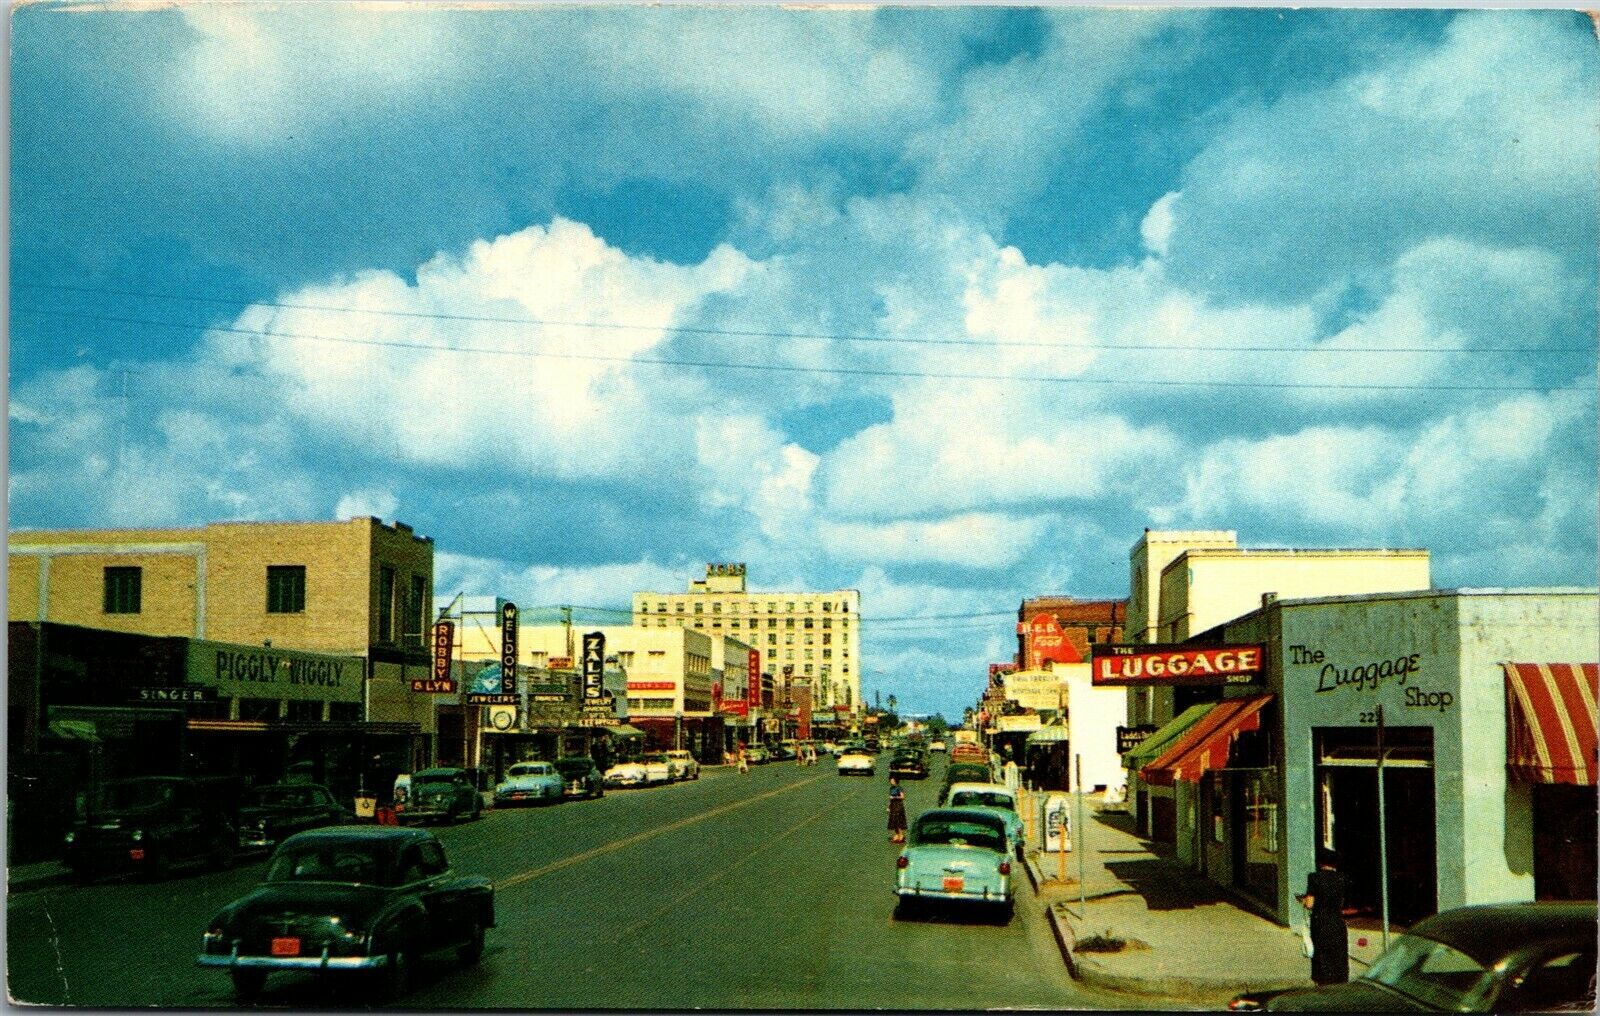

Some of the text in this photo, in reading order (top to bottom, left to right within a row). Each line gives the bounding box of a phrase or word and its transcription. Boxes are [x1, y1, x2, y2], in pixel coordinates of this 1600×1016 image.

[437, 625, 449, 678] ROBBY
[504, 608, 515, 689] WELDONS
[1113, 647, 1134, 655] THE
[1289, 644, 1325, 665] The
[215, 651, 344, 687] PIGGLY WIGGLY
[586, 637, 602, 698] ZALES
[1101, 650, 1260, 679] LUGGAGE
[1315, 653, 1421, 693] Luggage
[426, 680, 451, 691] LYN
[1226, 675, 1252, 683] SHOP
[140, 689, 203, 700] SINGER
[469, 695, 515, 703] JEWELERS
[1404, 686, 1454, 713] Shop
